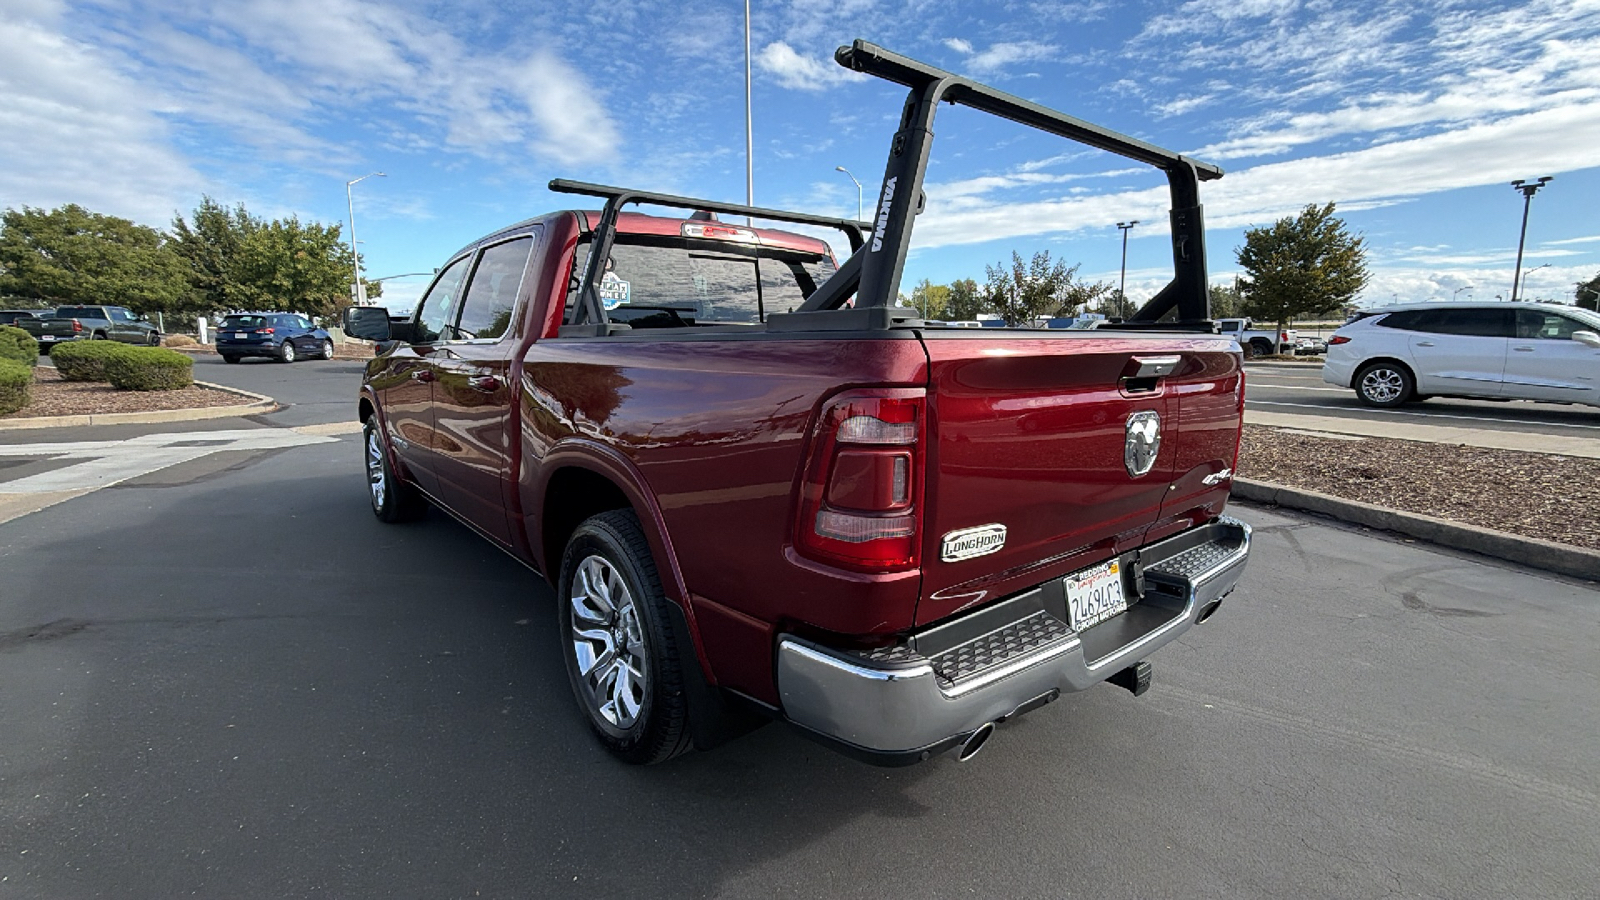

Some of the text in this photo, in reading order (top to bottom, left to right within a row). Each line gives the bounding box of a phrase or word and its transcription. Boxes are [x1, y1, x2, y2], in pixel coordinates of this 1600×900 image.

[871, 176, 898, 253] YAKIMA
[944, 532, 1005, 556] LONGHORN
[1079, 563, 1109, 580] REDDING
[1076, 603, 1125, 632] CROWN MOTORS
